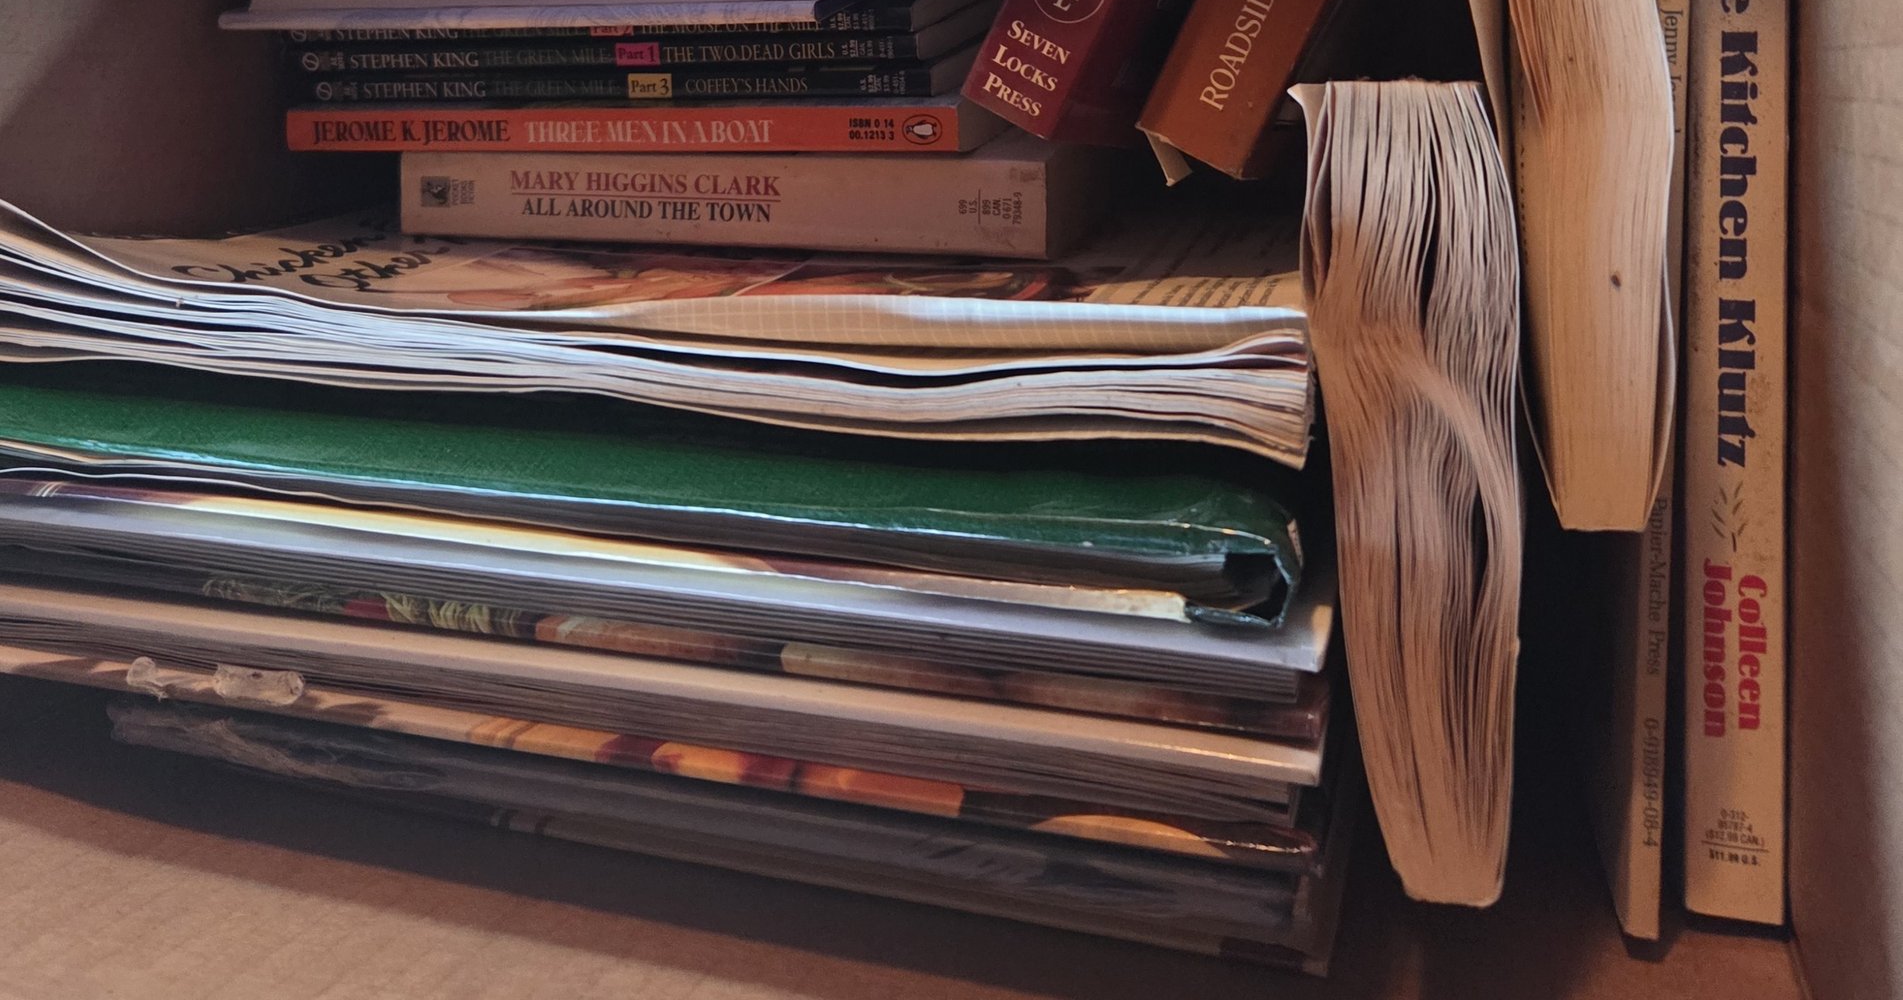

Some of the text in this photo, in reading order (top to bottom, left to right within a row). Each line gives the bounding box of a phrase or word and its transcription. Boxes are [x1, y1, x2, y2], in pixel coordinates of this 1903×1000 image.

[350, 51, 429, 70] STEPHEN
[433, 51, 480, 68] KING
[619, 48, 645, 61] Part
[647, 46, 656, 63] 1
[664, 46, 694, 62] THE
[697, 46, 739, 62] TWO
[740, 45, 786, 62] DEAD
[789, 42, 836, 60] GIRLS
[1005, 18, 1071, 66] SEVEN
[363, 82, 438, 99] STEPHEN
[442, 81, 487, 98] KING
[631, 80, 657, 94] Part
[659, 78, 671, 95] 3
[684, 77, 753, 94] COFFEY'S
[755, 76, 810, 93] HANDS
[991, 43, 1058, 93] LOCKS
[981, 71, 1043, 118] PRESS
[312, 120, 396, 145] JEROME
[422, 119, 511, 145] JEROME
[524, 121, 601, 144] THREE
[606, 120, 657, 143] MEN
[663, 120, 693, 143] IN
[694, 120, 712, 143] A
[713, 119, 775, 142] BOAT
[848, 118, 895, 129] ISBN 0 14
[1718, 30, 1759, 281] Kitchen
[510, 170, 781, 197] MARY HIGGINS CLARK
[521, 198, 771, 222] ALL AROUND THE TOWN
[1716, 296, 1757, 469] Klutz
[1647, 495, 1668, 676] Papier-Mache Press
[1703, 557, 1733, 739] Johnson
[1737, 573, 1768, 731] Colleen
